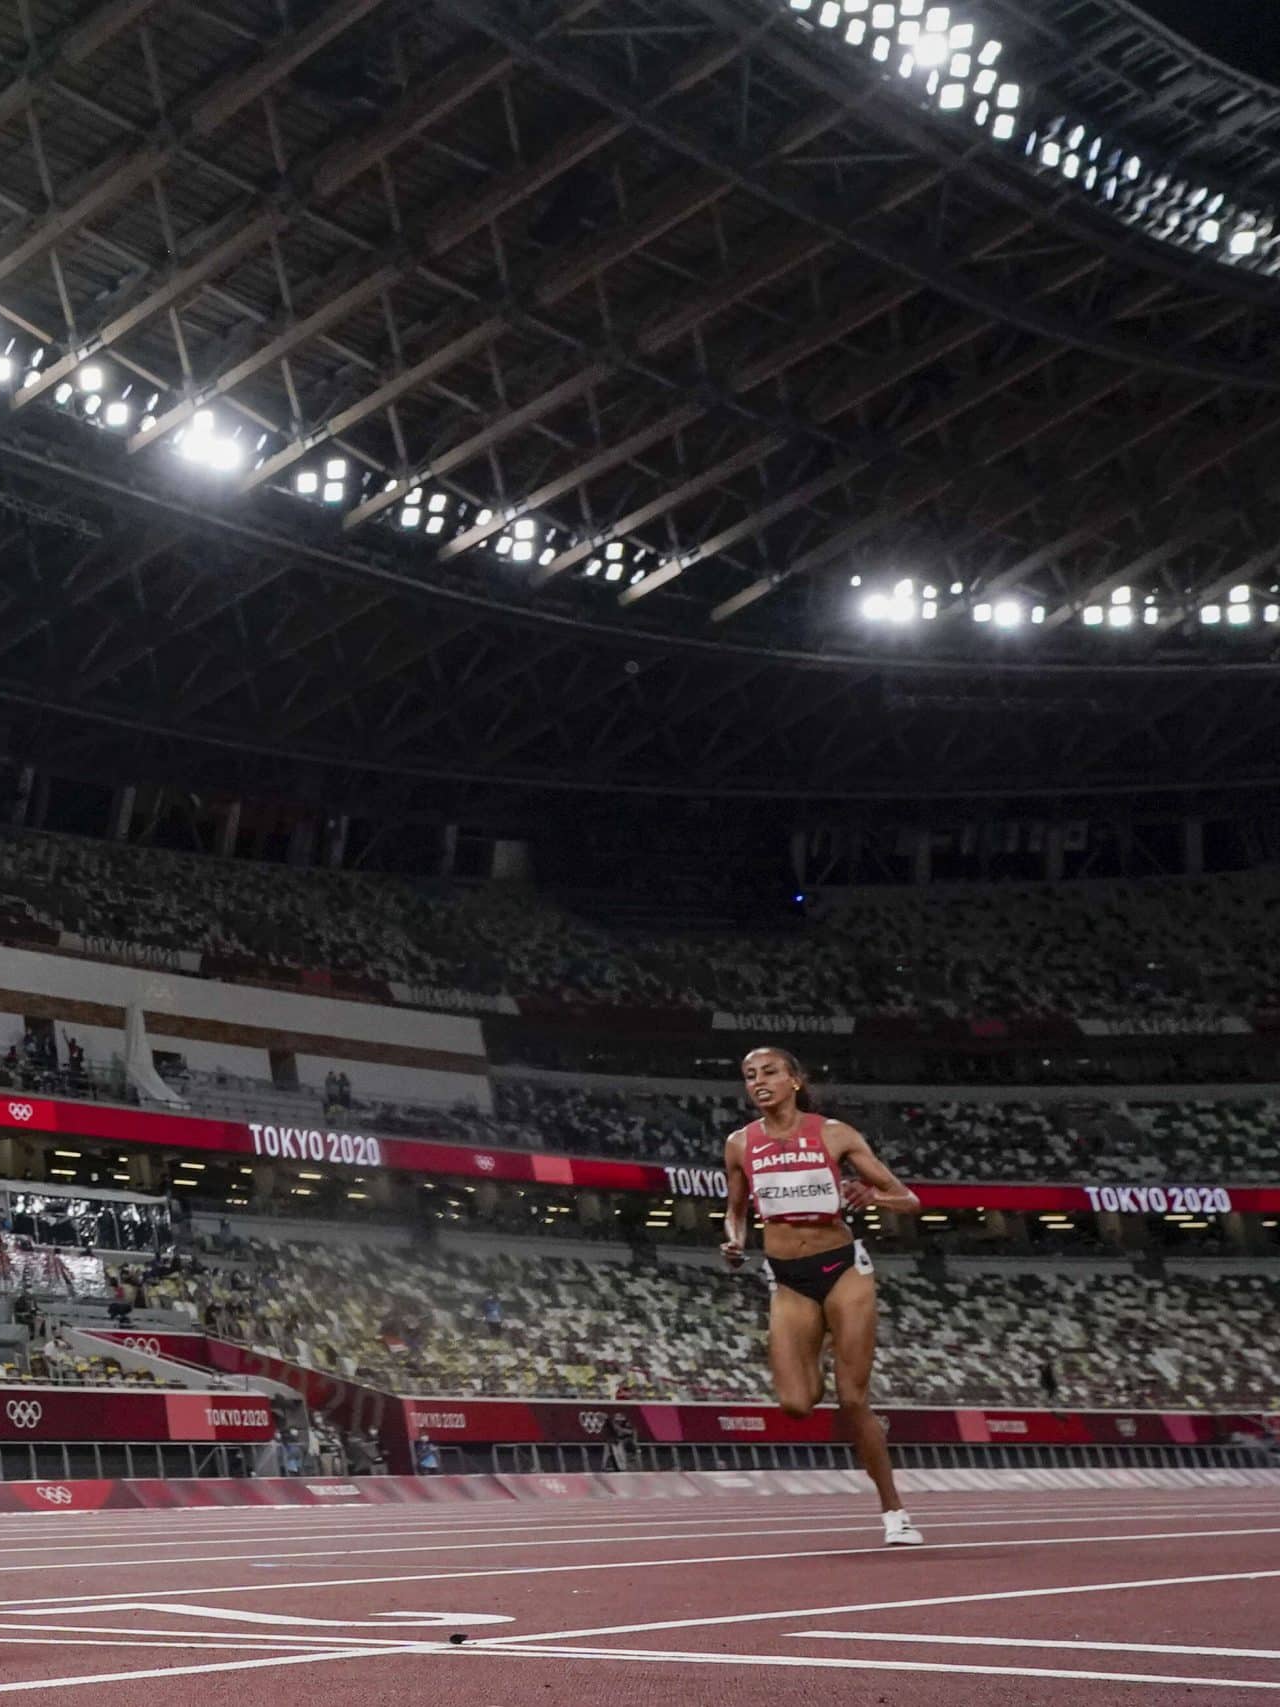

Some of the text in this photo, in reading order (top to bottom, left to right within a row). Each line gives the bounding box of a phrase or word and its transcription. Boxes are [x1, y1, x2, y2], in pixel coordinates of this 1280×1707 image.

[248, 1124, 382, 1167] TOKYO 2020
[752, 1151, 824, 1170] BAHRAIN
[665, 1167, 728, 1198] TOKYO
[1085, 1186, 1232, 1213] TOKYO 2020
[205, 1409, 269, 1426] TOKYO 2020
